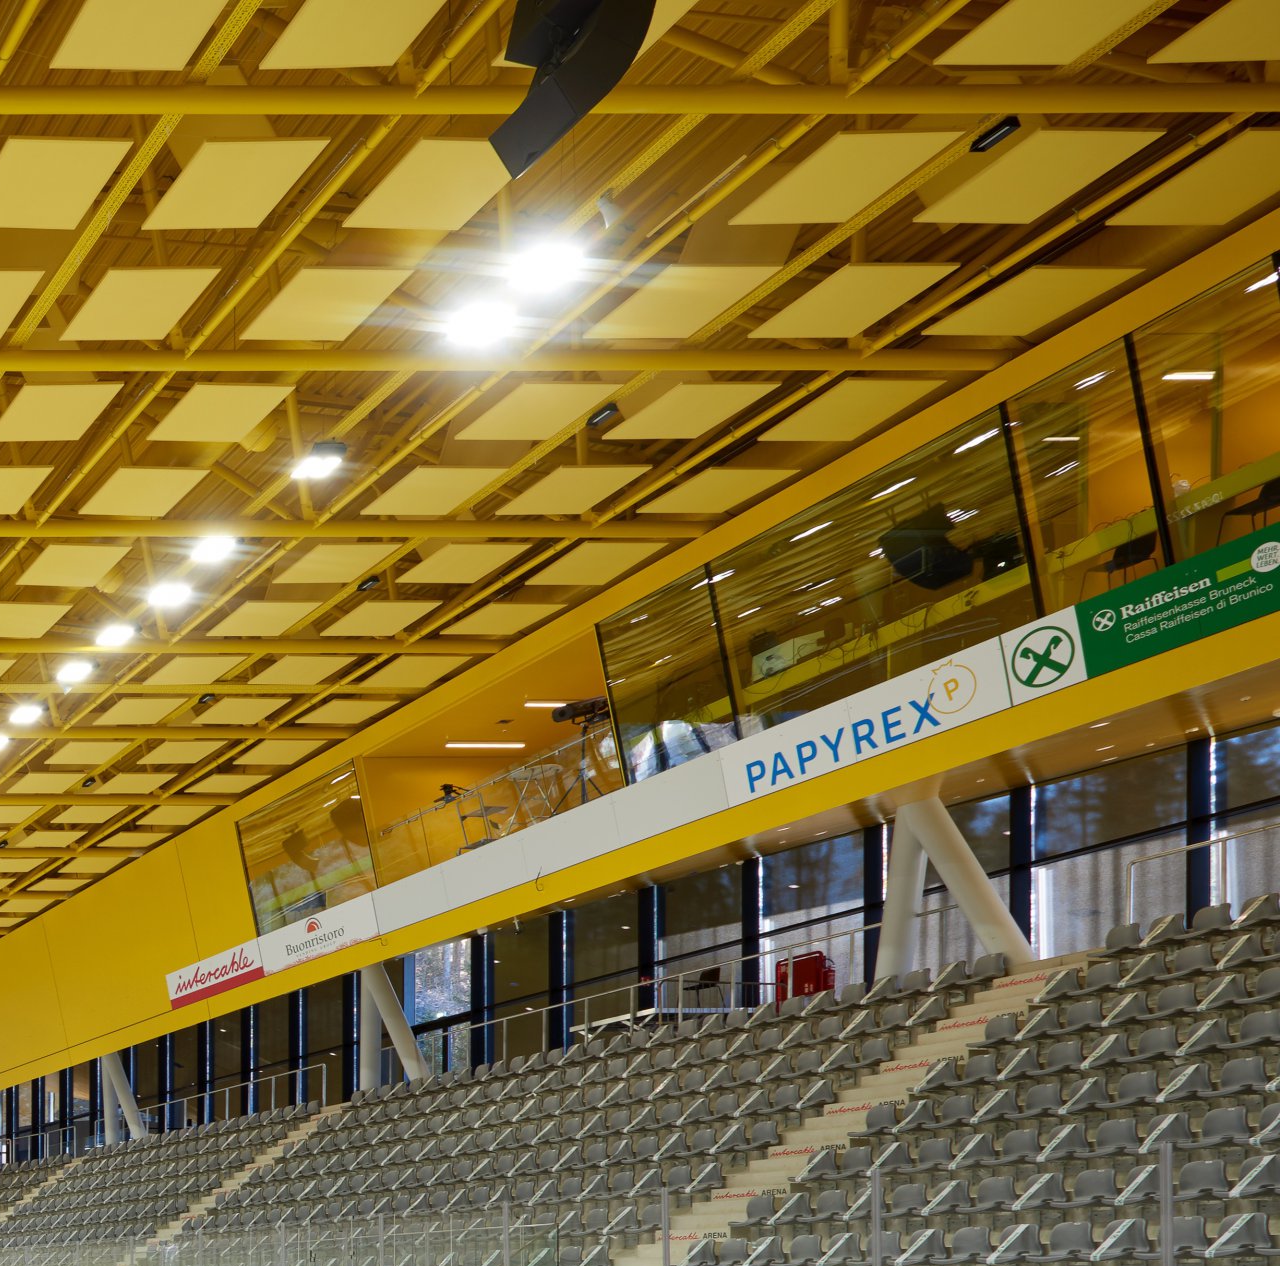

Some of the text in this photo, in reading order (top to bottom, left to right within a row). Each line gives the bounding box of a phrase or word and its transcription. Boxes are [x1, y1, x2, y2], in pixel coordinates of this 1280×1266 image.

[1120, 577, 1212, 620] Raiffeisen
[1123, 577, 1257, 633] Raiffeisenkasse Bruneck
[1125, 582, 1274, 644] Cassa Raiffeisen di Brunico
[745, 692, 941, 793] PAPYREX
[285, 926, 345, 956] Buonristoro
[175, 948, 255, 994] intercable
[761, 1188, 787, 1196] ARENA
[702, 1232, 728, 1240] ARENA
